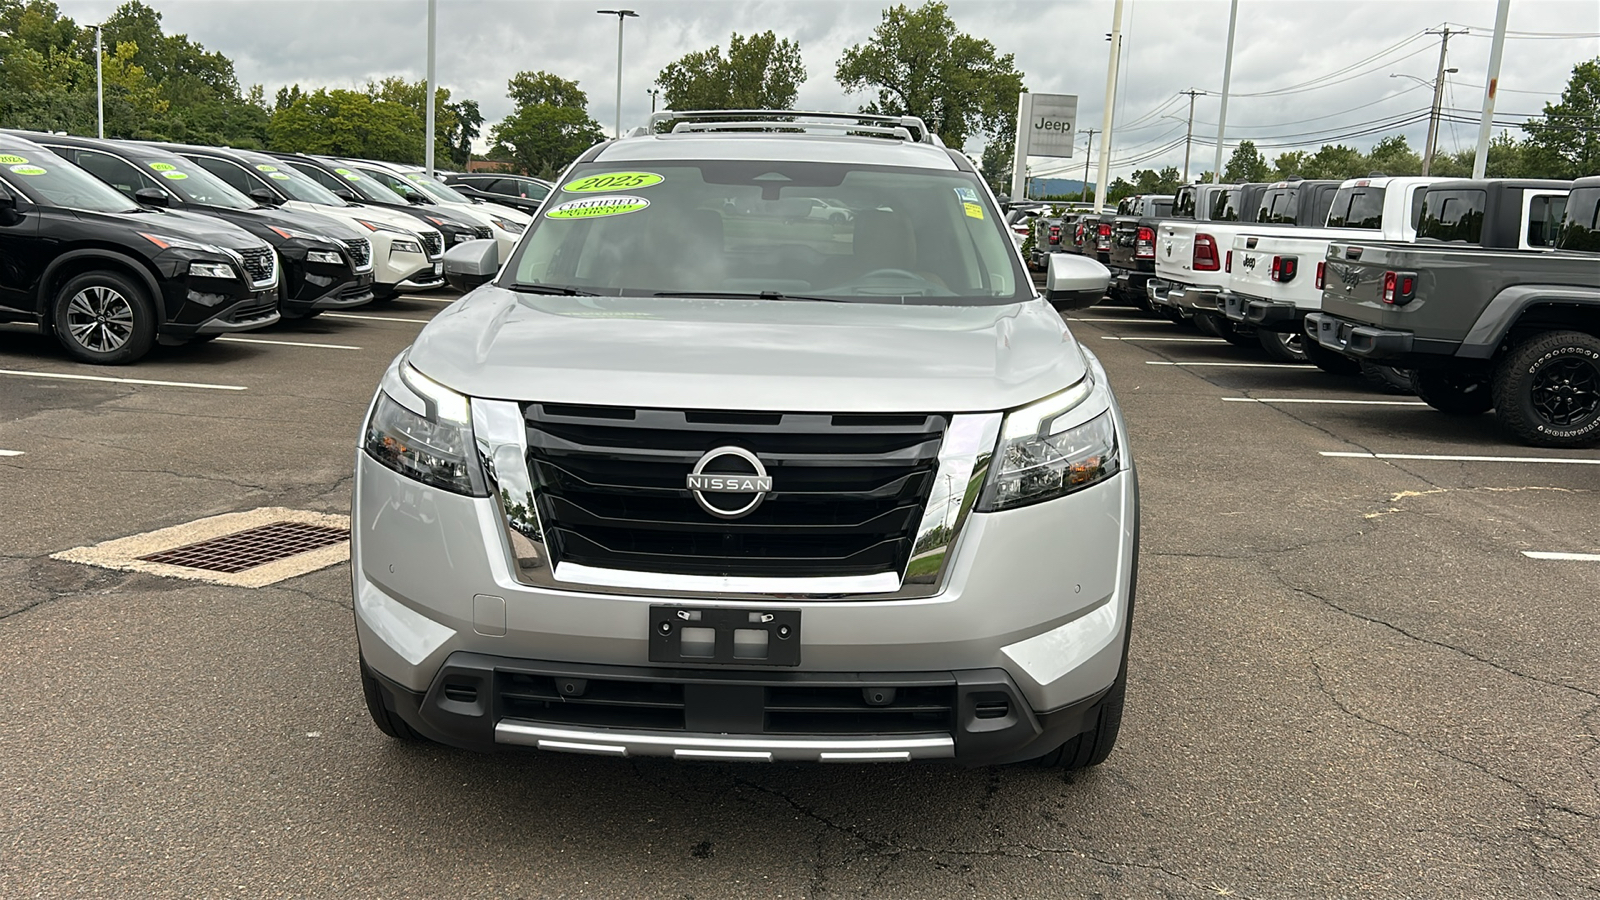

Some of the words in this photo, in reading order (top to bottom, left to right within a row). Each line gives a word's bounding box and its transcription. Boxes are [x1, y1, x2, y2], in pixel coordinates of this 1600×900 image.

[1034, 117, 1070, 133] Jeep
[576, 175, 650, 190] 2025
[558, 198, 639, 210] CERTIFIED
[1243, 253, 1256, 270] Jeep
[1342, 267, 1359, 288] Jeep
[688, 477, 770, 490] NISSAN
